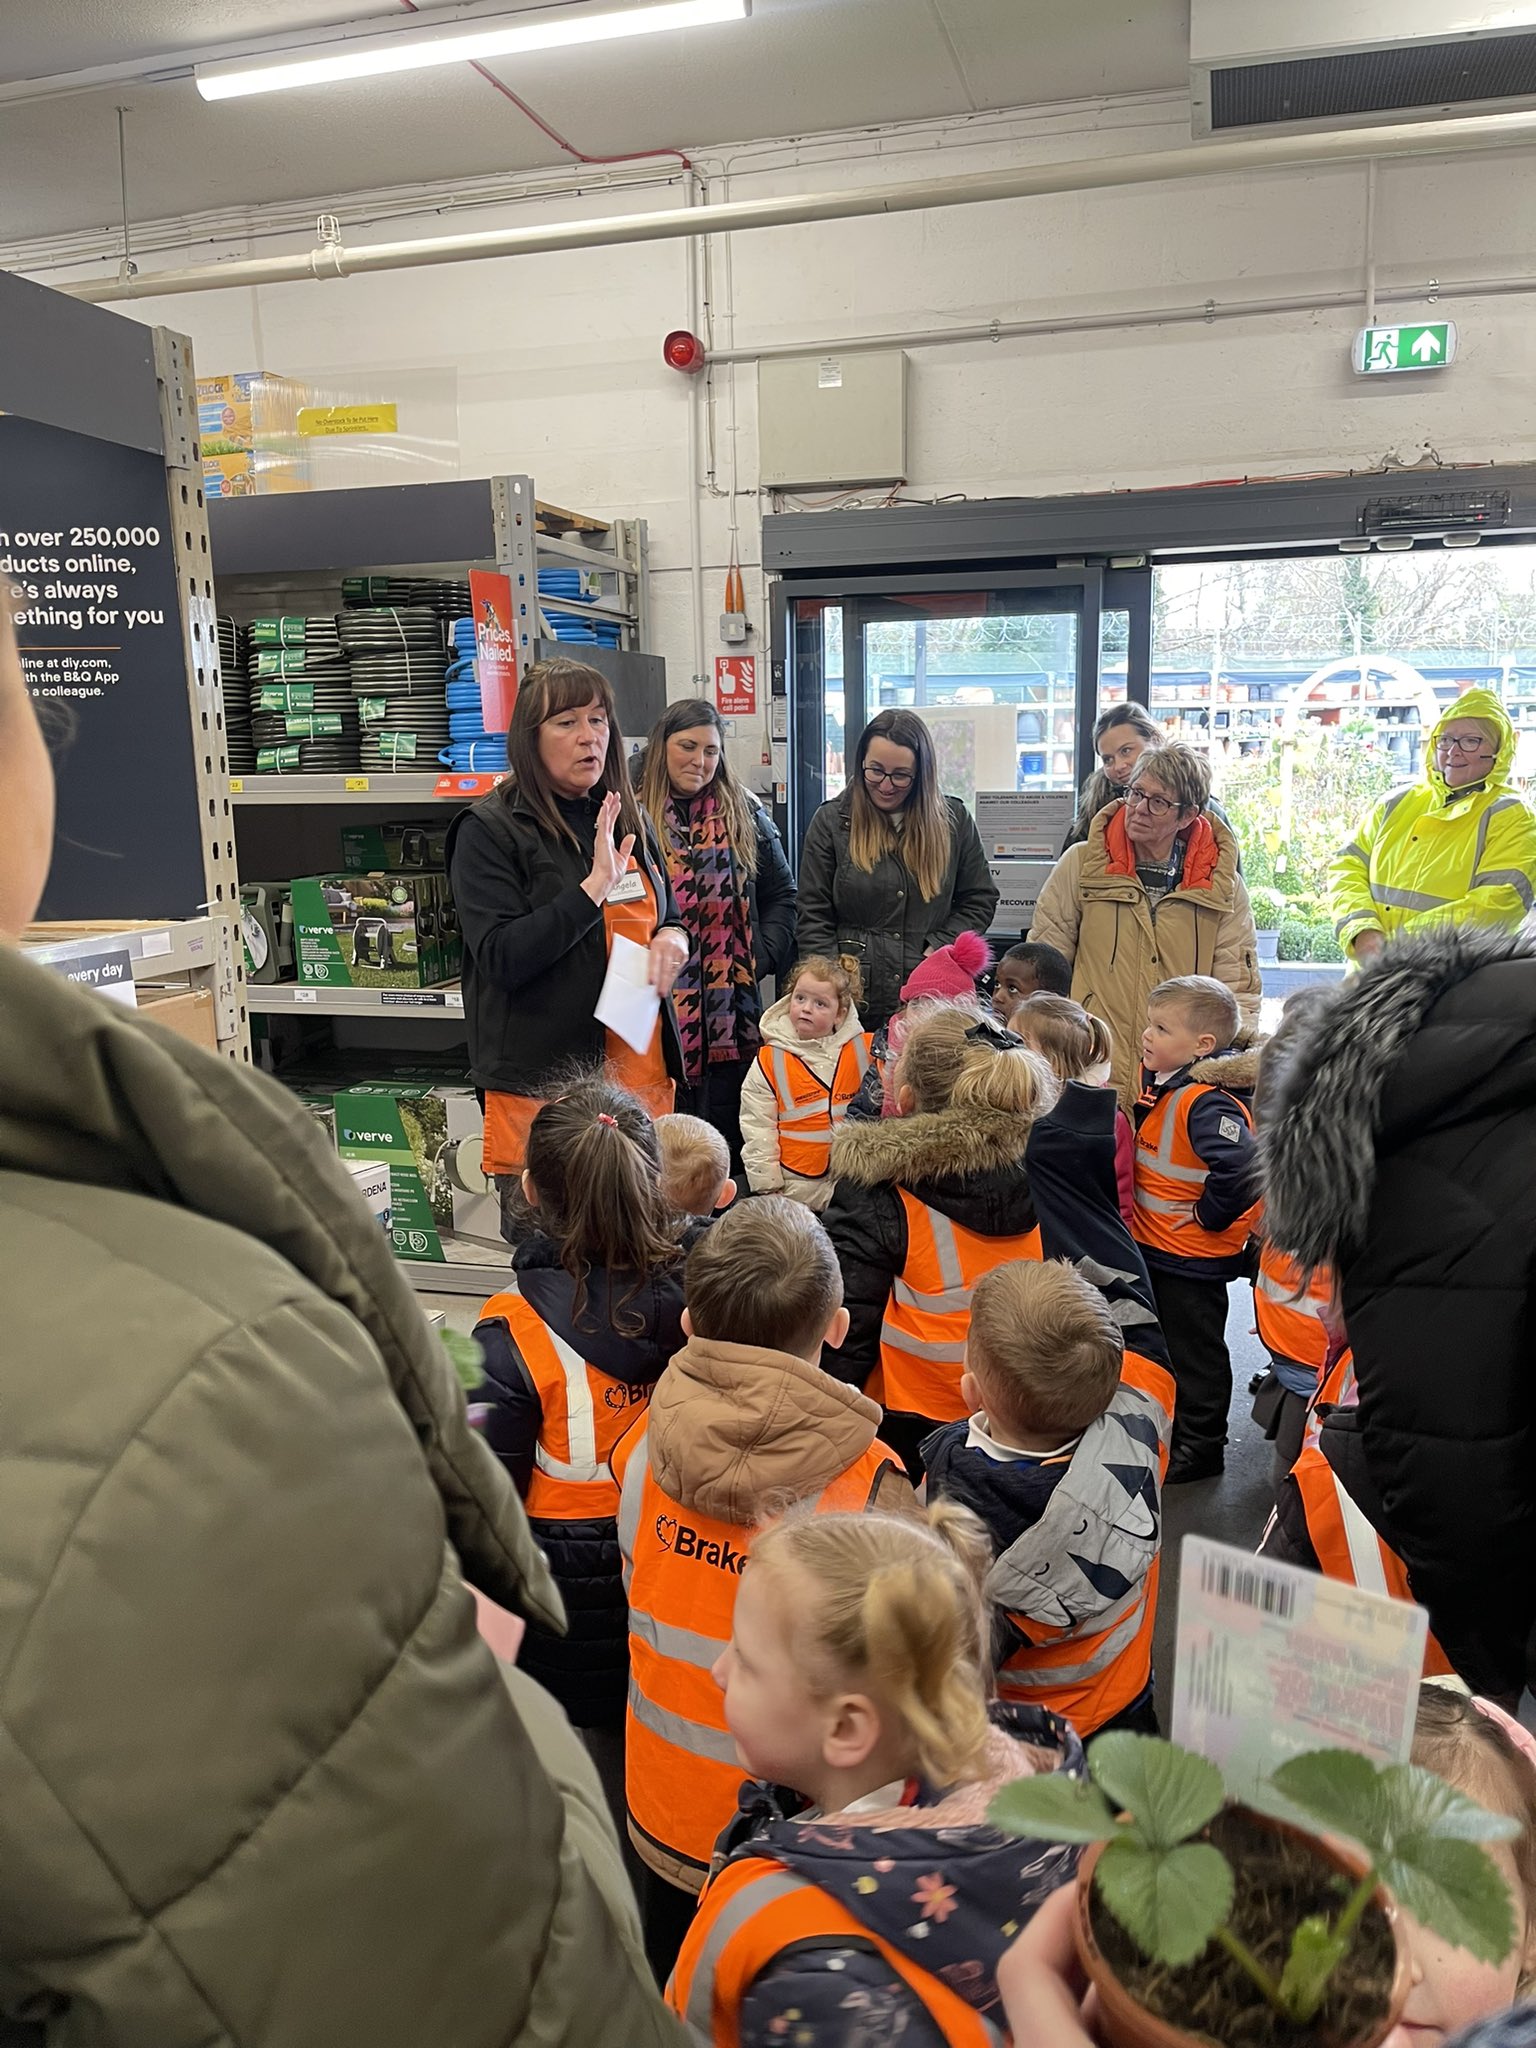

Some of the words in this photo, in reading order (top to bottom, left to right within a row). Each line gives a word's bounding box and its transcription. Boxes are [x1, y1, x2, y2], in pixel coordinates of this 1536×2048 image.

[14, 531, 64, 547] over
[69, 526, 160, 549] 250,000
[0, 554, 60, 573] ducts
[65, 553, 137, 575] online,
[44, 580, 118, 604] always
[13, 606, 83, 630] ething
[87, 606, 119, 625] for
[124, 609, 164, 630] you
[478, 622, 513, 644] Prices.
[479, 642, 515, 663] Nailed.
[21, 658, 44, 669] line
[46, 659, 59, 668] at
[62, 657, 112, 670] diy.com,
[25, 673, 38, 683] th
[40, 672, 61, 682] the
[64, 672, 92, 682] B&Q
[94, 672, 120, 684] App
[32, 688, 40, 696] a
[42, 685, 105, 698] colleague.
[308, 926, 334, 935] verve
[67, 969, 100, 982] every
[102, 963, 124, 978] day
[356, 1131, 393, 1143] verve
[362, 1182, 387, 1198] RDENA
[628, 1384, 655, 1406] Br
